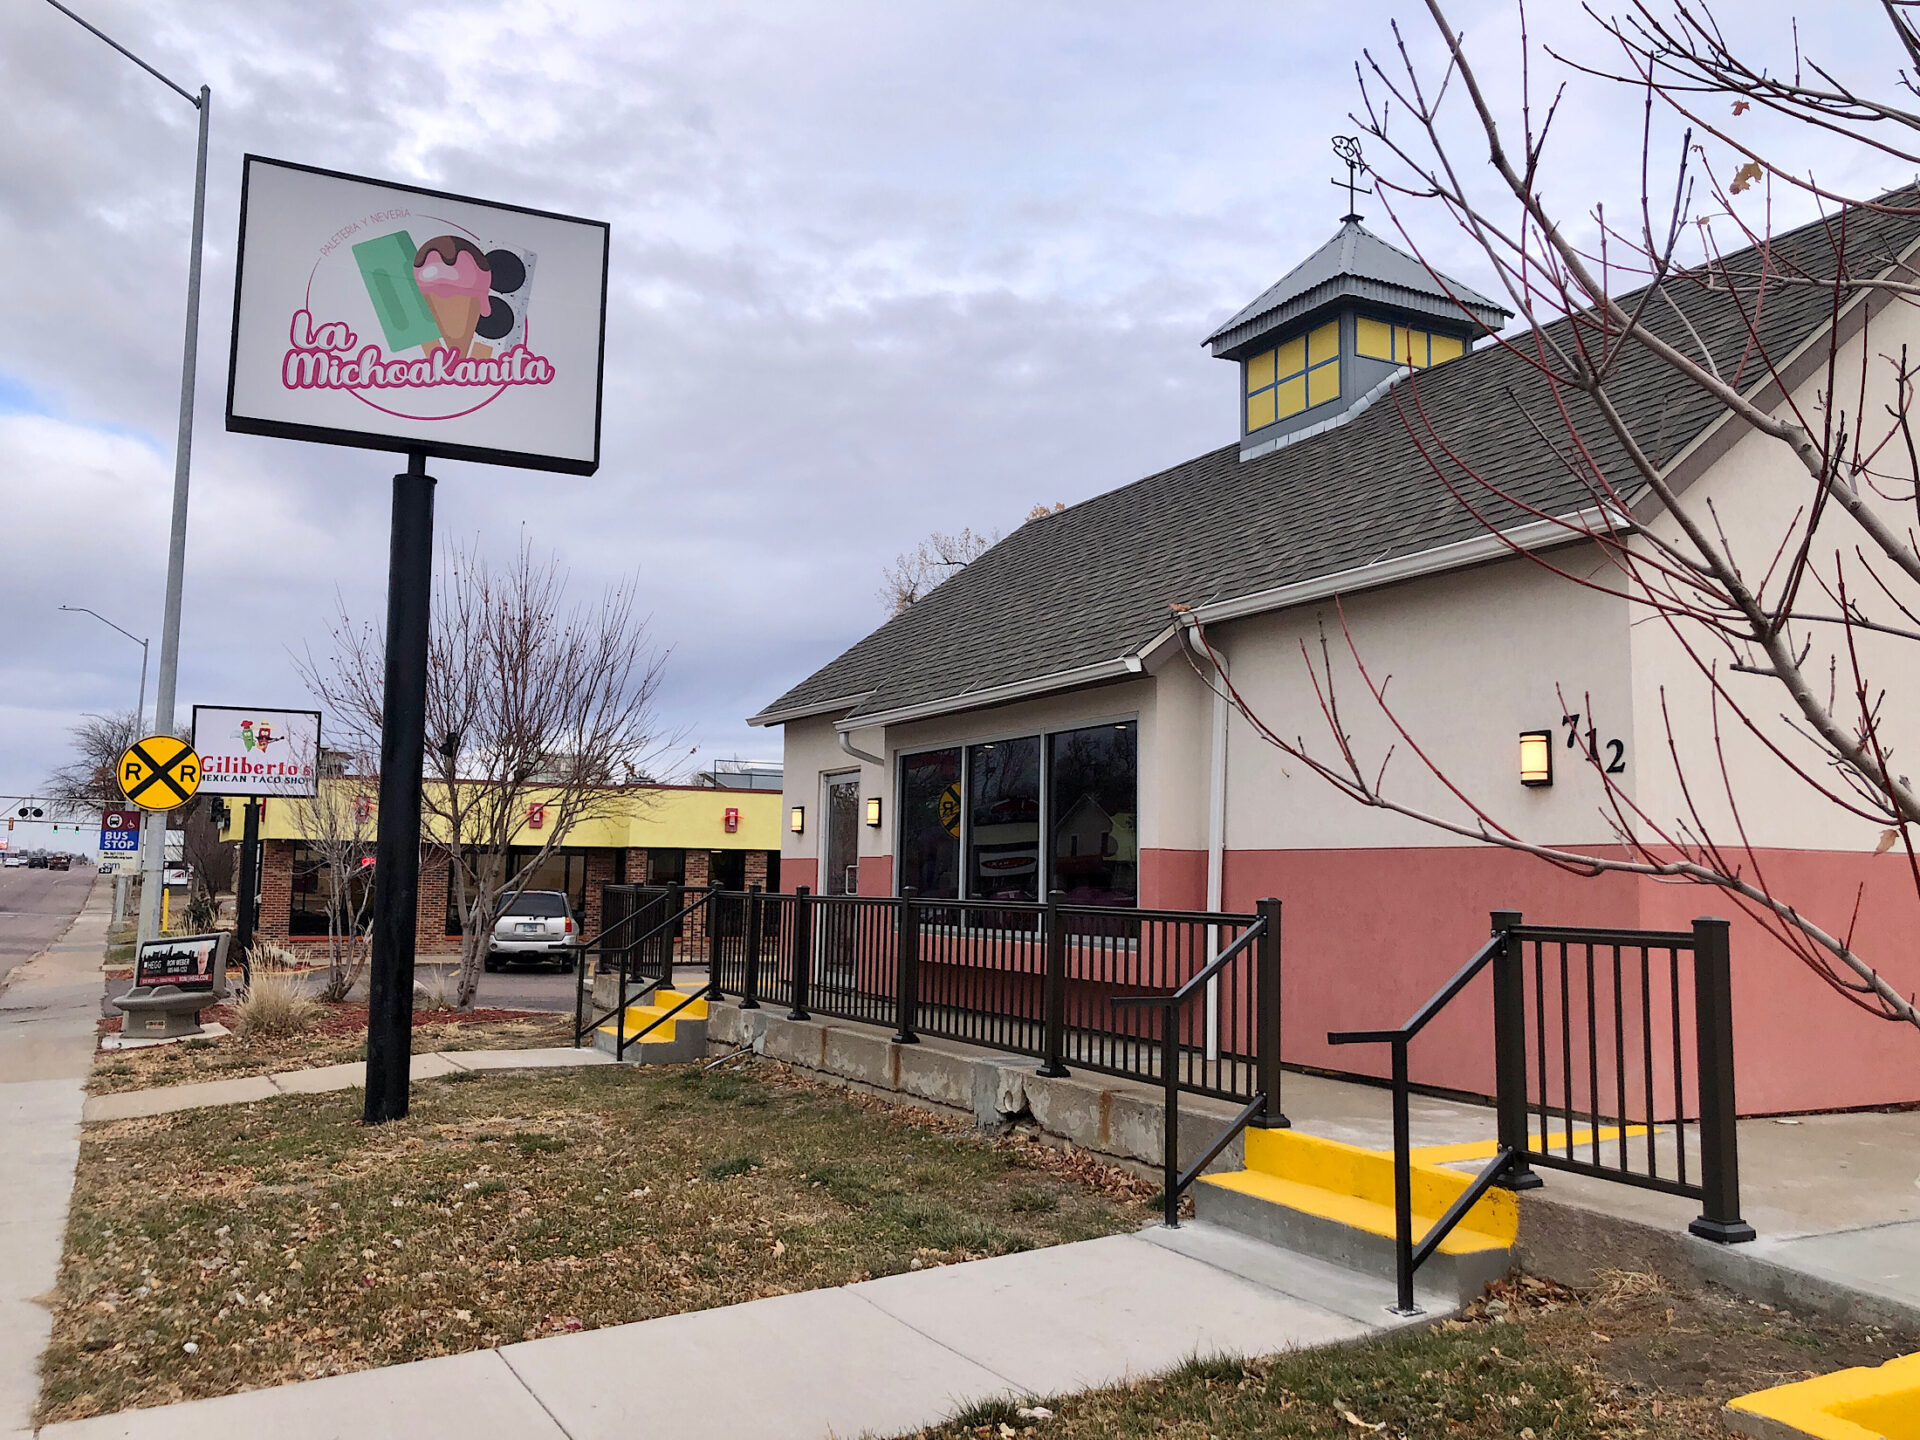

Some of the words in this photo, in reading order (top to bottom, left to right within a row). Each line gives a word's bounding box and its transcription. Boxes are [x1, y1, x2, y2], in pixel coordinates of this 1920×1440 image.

[319, 222, 362, 257] PALETERIA
[370, 207, 411, 224] NEVERIA
[290, 309, 357, 351] La
[282, 344, 555, 390] Michoakanita
[1562, 713, 1626, 773] 712
[125, 762, 142, 781] R
[180, 764, 196, 783] R
[251, 775, 282, 784] TACO
[103, 840, 135, 850] STOP
[104, 831, 128, 841] BUS
